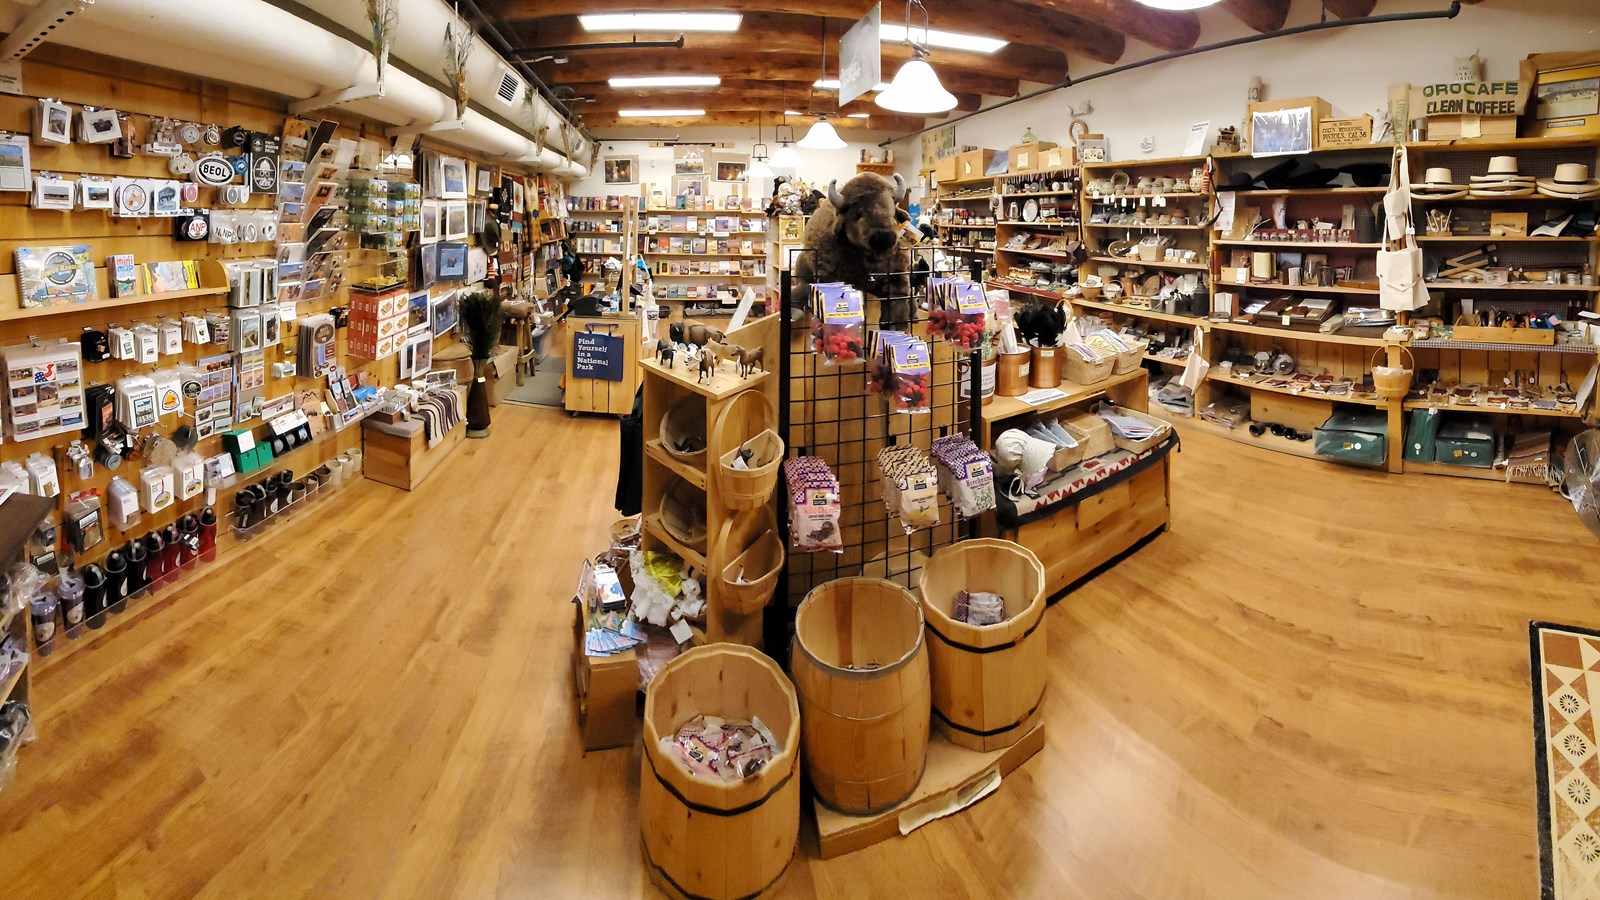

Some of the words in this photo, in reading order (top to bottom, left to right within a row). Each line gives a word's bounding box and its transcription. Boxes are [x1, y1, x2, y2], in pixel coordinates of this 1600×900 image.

[1423, 82, 1518, 97] OROCAFE
[1426, 99, 1464, 114] CLEAN
[1466, 99, 1515, 115] COFFEE
[203, 164, 227, 177] BEOL
[117, 257, 133, 265] mini
[117, 264, 134, 272] map
[578, 344, 608, 352] Yourself
[577, 357, 609, 366] National
